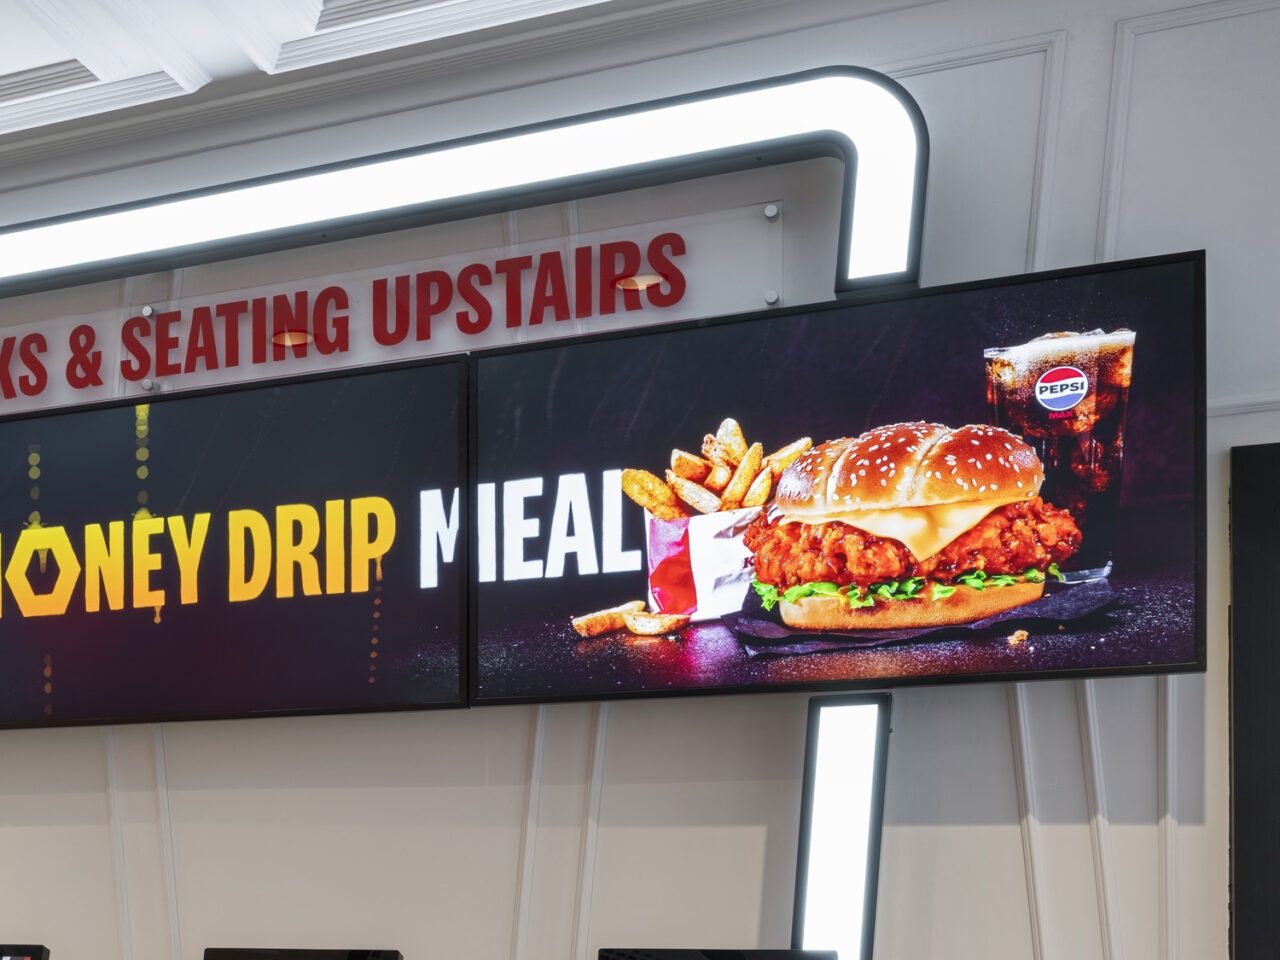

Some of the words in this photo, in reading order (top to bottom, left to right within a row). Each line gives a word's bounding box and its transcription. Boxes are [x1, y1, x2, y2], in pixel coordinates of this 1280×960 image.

[65, 324, 103, 390] &
[120, 286, 350, 382] SEATING
[372, 232, 687, 346] UPSTAIRS
[1039, 381, 1084, 395] PEPSI
[1048, 411, 1073, 420] MAX
[228, 496, 396, 602] DRIP
[420, 470, 642, 589] MEAL
